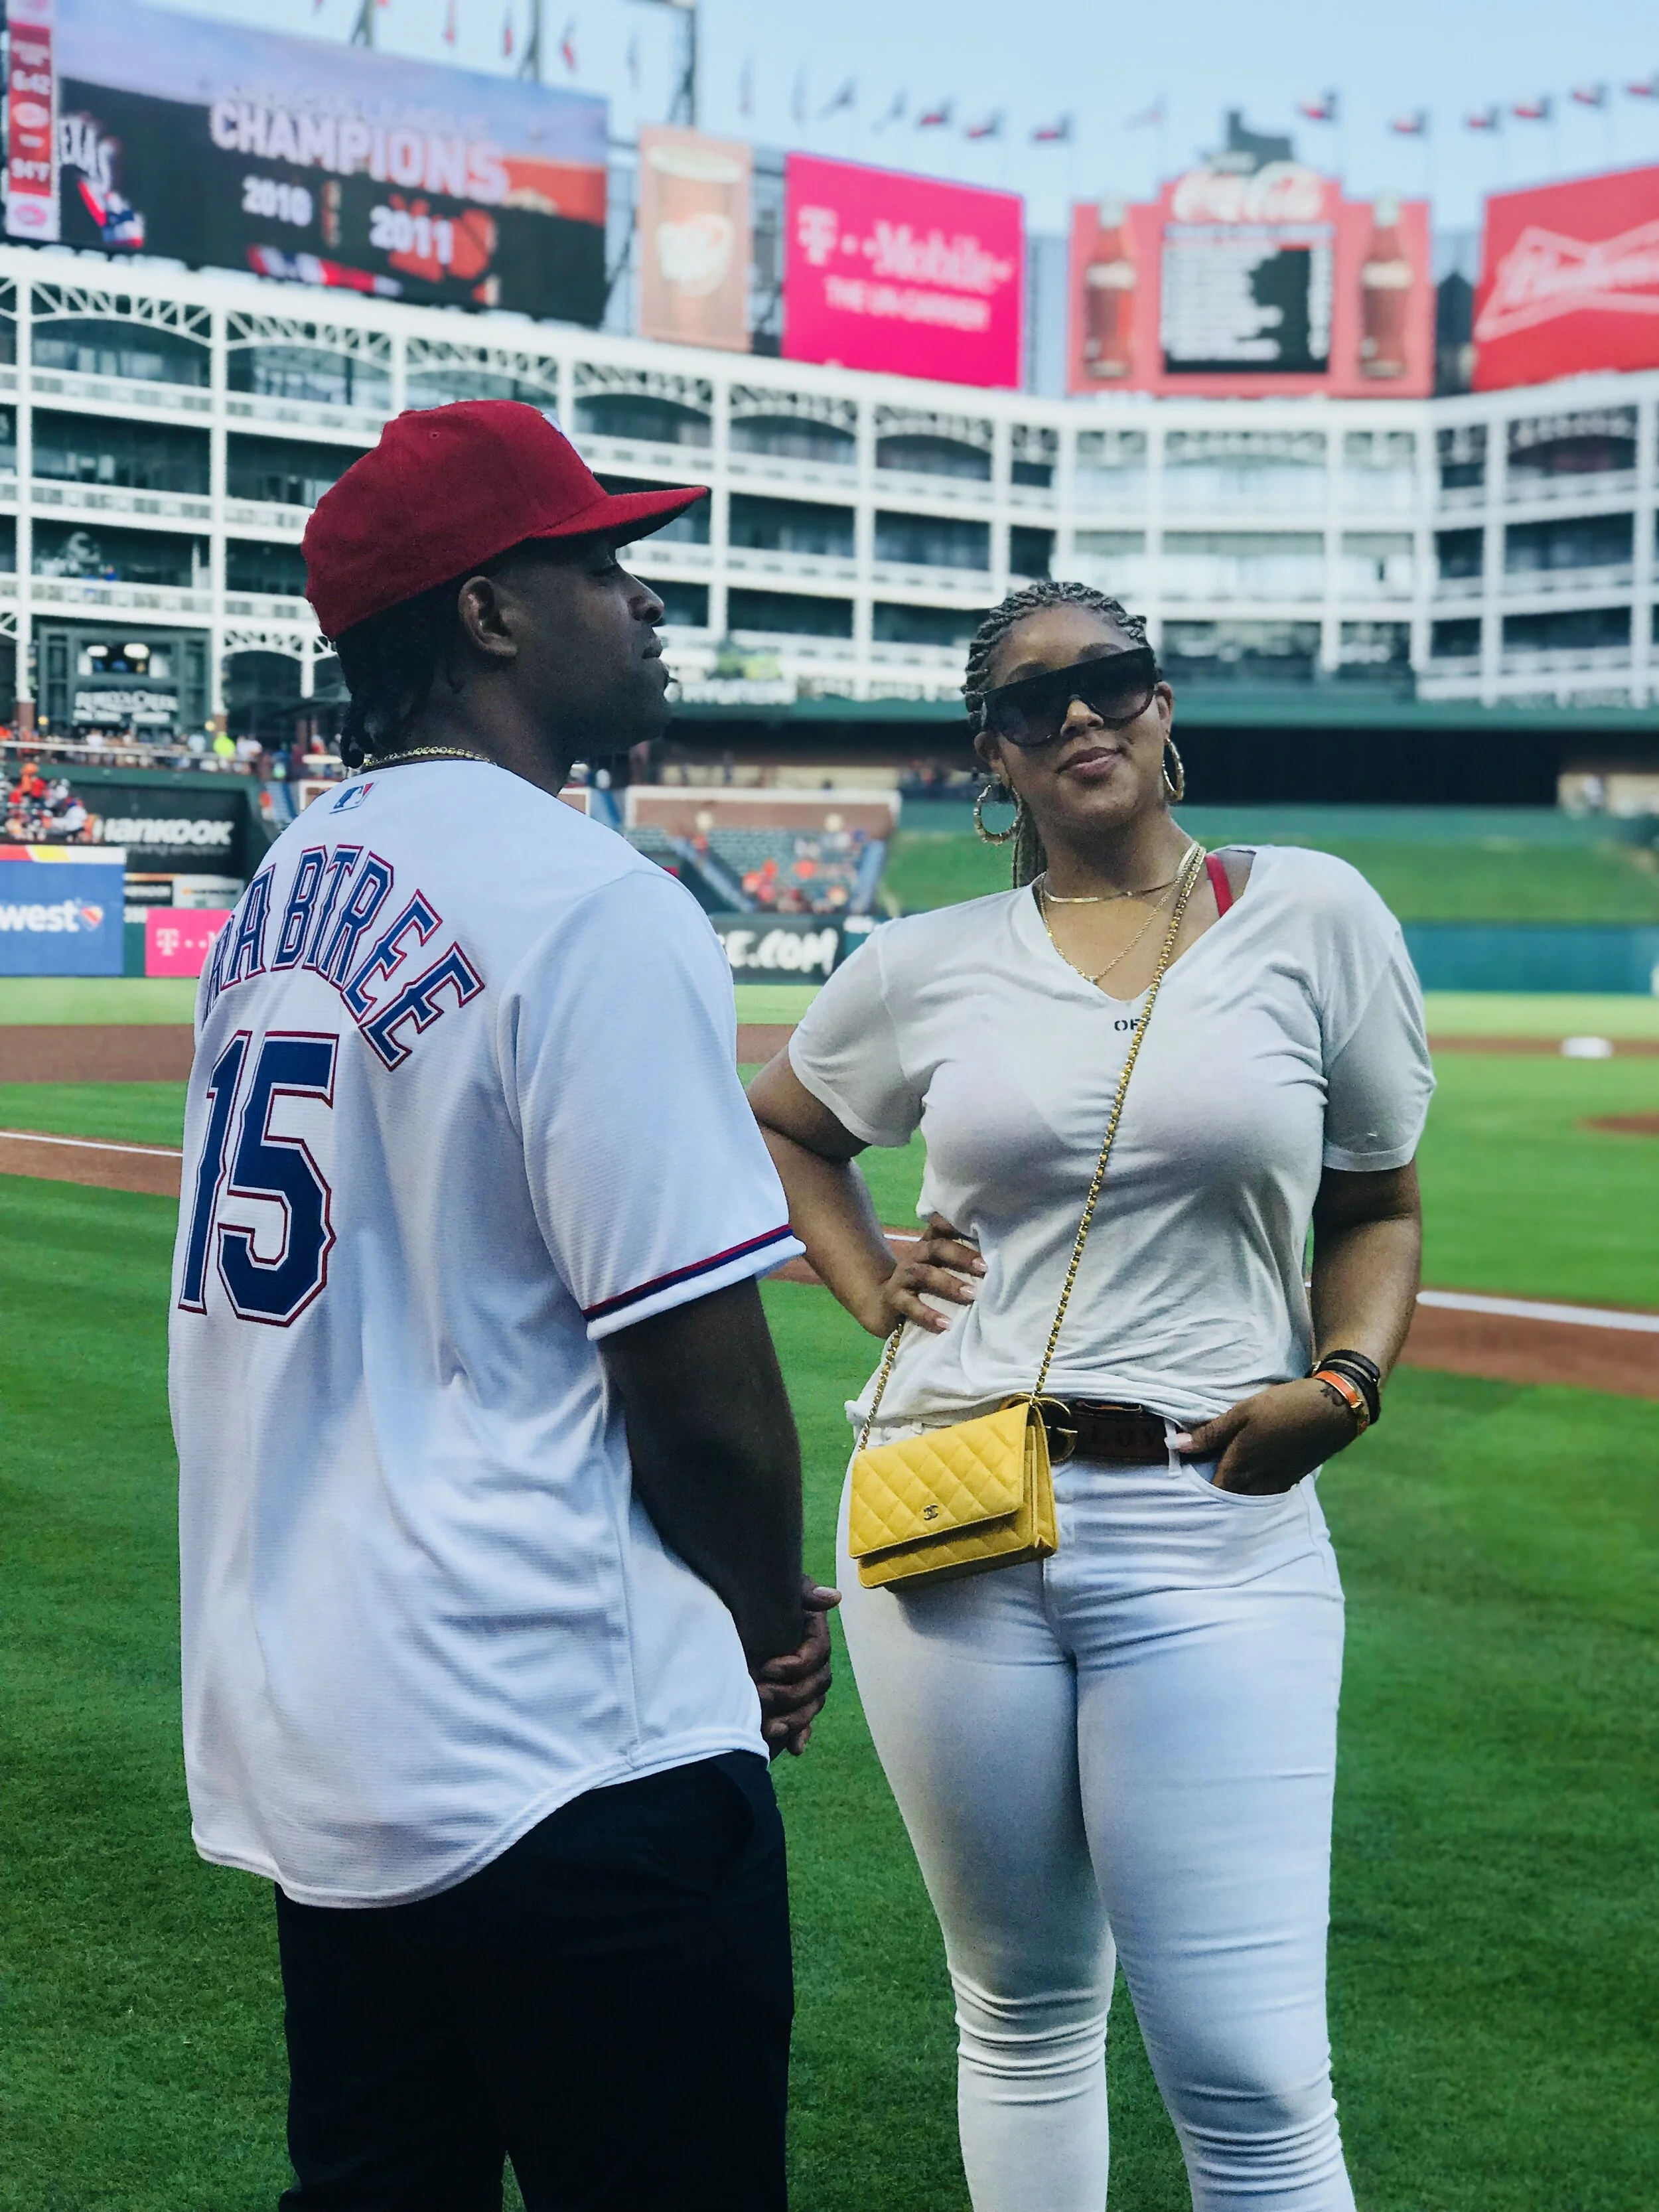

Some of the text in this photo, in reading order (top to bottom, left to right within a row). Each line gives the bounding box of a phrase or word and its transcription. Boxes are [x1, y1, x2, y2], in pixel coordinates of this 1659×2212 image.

[210, 100, 510, 204] CHAMPIONS
[242, 175, 454, 265] 2010 2011
[178, 1029, 339, 1327] 15
